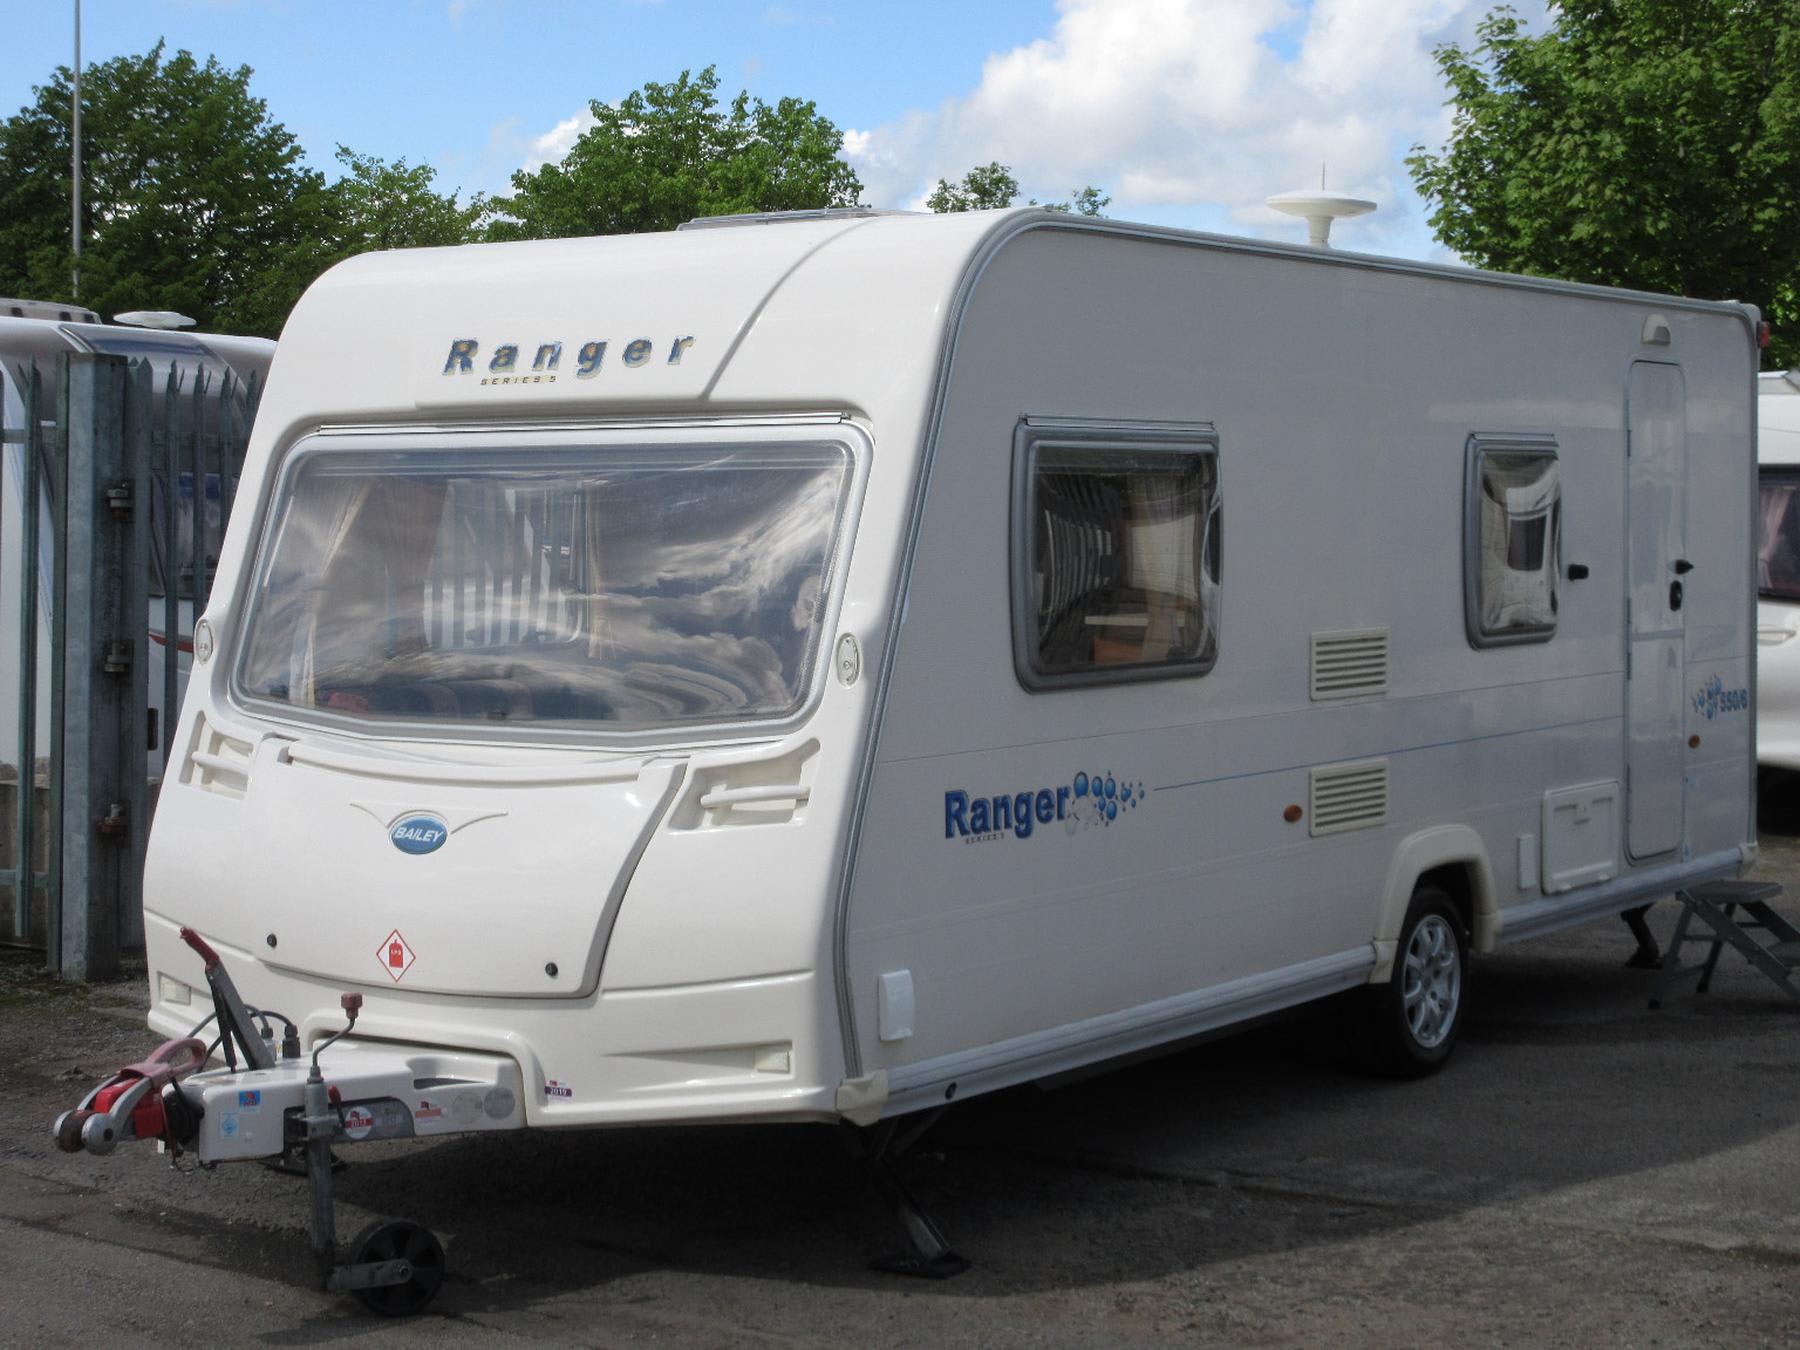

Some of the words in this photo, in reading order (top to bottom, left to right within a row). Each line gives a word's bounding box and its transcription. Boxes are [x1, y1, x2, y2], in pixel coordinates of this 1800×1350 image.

[442, 335, 695, 380] Ranger
[480, 376, 541, 386] SERIES
[945, 785, 1070, 838] Ranger
[394, 826, 444, 842] BAILEY
